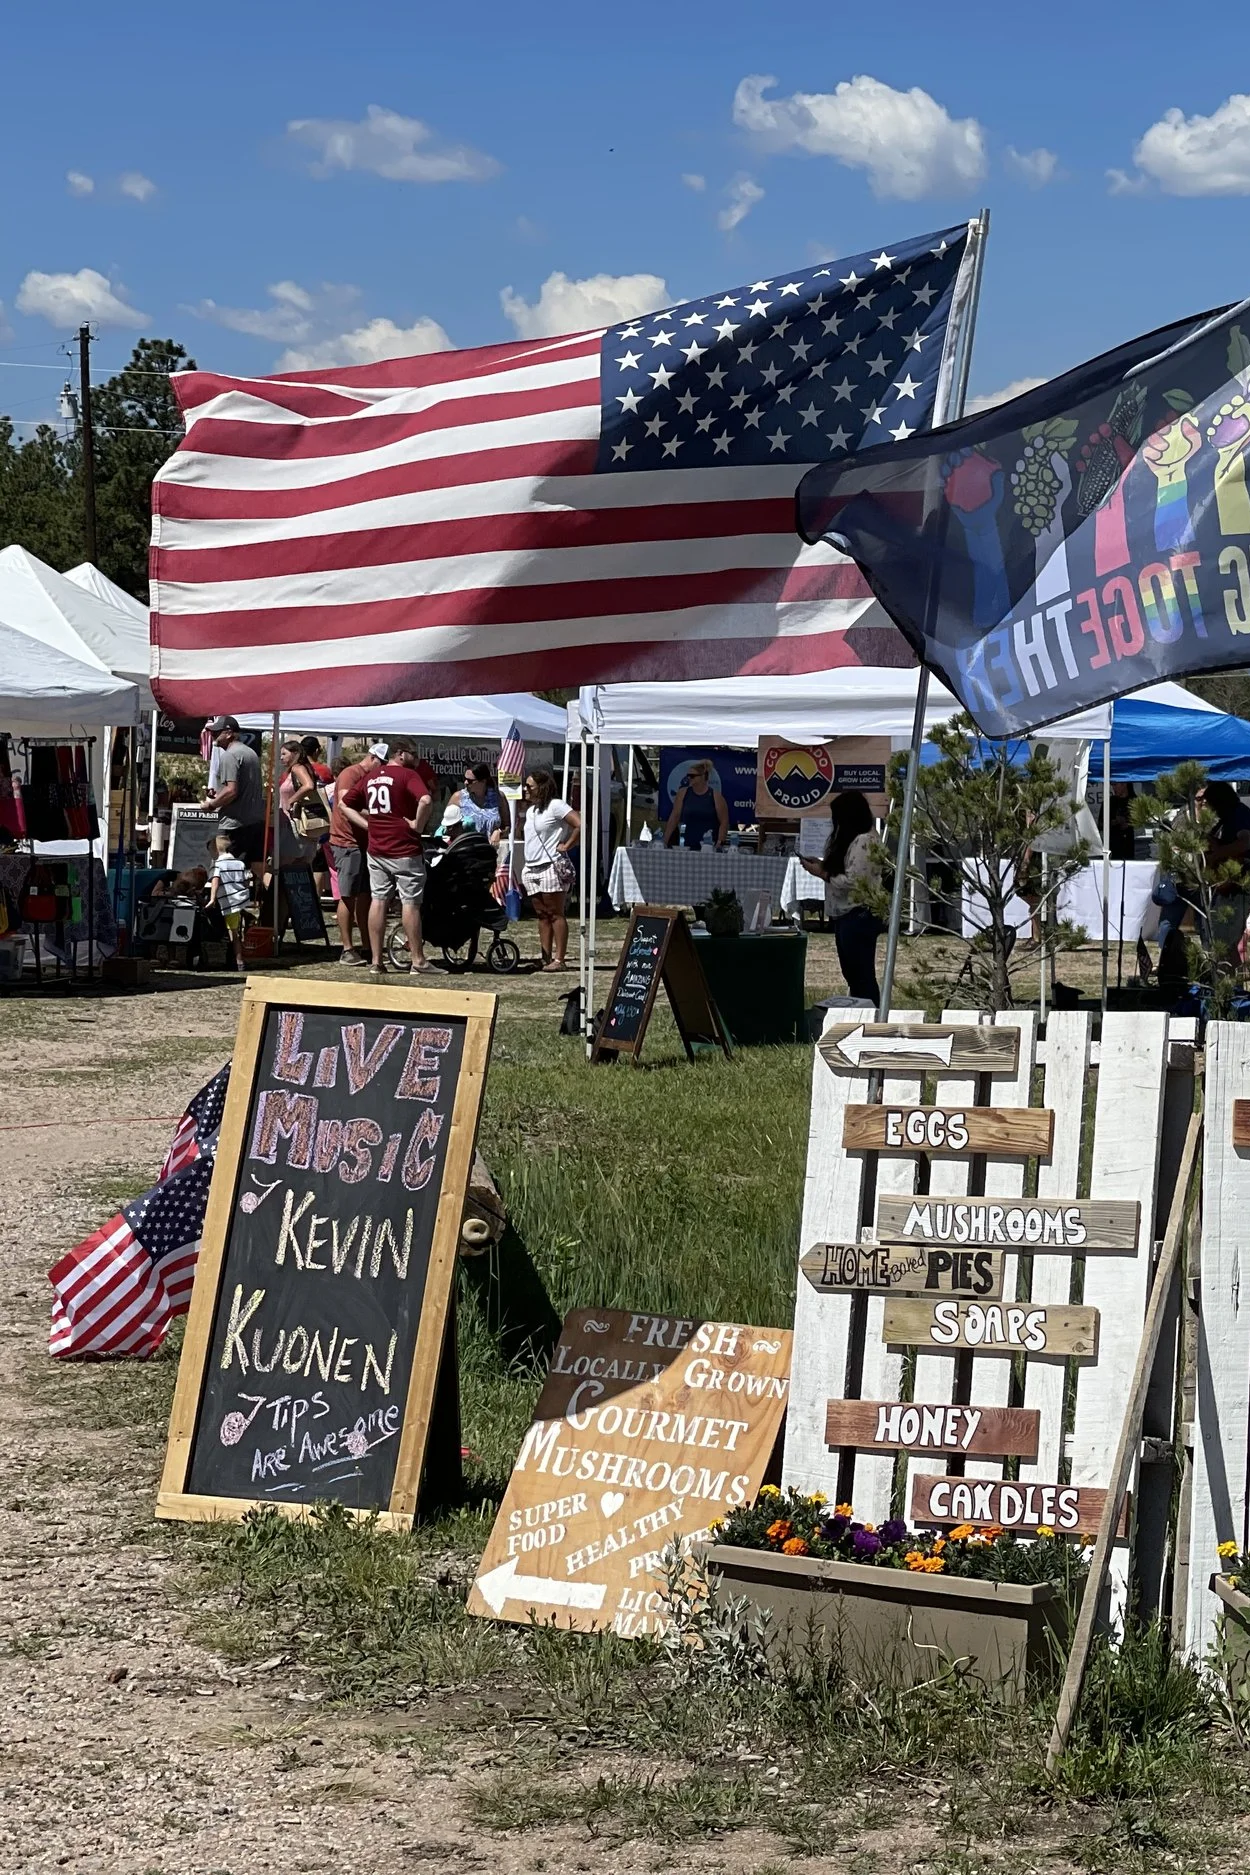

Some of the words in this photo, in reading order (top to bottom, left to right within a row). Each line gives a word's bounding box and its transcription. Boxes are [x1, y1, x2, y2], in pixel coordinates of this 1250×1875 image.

[438, 742, 467, 763] Cattle
[468, 748, 500, 767] Compa
[767, 745, 828, 768] CODO
[367, 785, 391, 814] 29
[774, 788, 821, 806] PROUD
[271, 1011, 453, 1103] LIVE
[885, 1110, 969, 1150] EGGS
[274, 1189, 415, 1280] KEVIN
[903, 1203, 1087, 1245] MUSHROOMS
[821, 1245, 890, 1287] HOME
[925, 1250, 993, 1294] PIES
[220, 1284, 398, 1394] KUONEN
[623, 1314, 744, 1357] FRESH
[930, 1301, 1047, 1351] SOAPS
[552, 1346, 669, 1385] LOCALLY
[684, 1358, 790, 1400] GROWN
[566, 1379, 748, 1451] GOURMET
[874, 1406, 981, 1448] HONEY
[514, 1419, 751, 1505] MUSHROOMS
[509, 1492, 588, 1533] SUPER
[928, 1481, 1080, 1528] CANDLES
[507, 1524, 566, 1558] FOOD
[564, 1498, 685, 1576] HEALTHY
[618, 1587, 676, 1614] LIO
[611, 1612, 676, 1639] MAN
